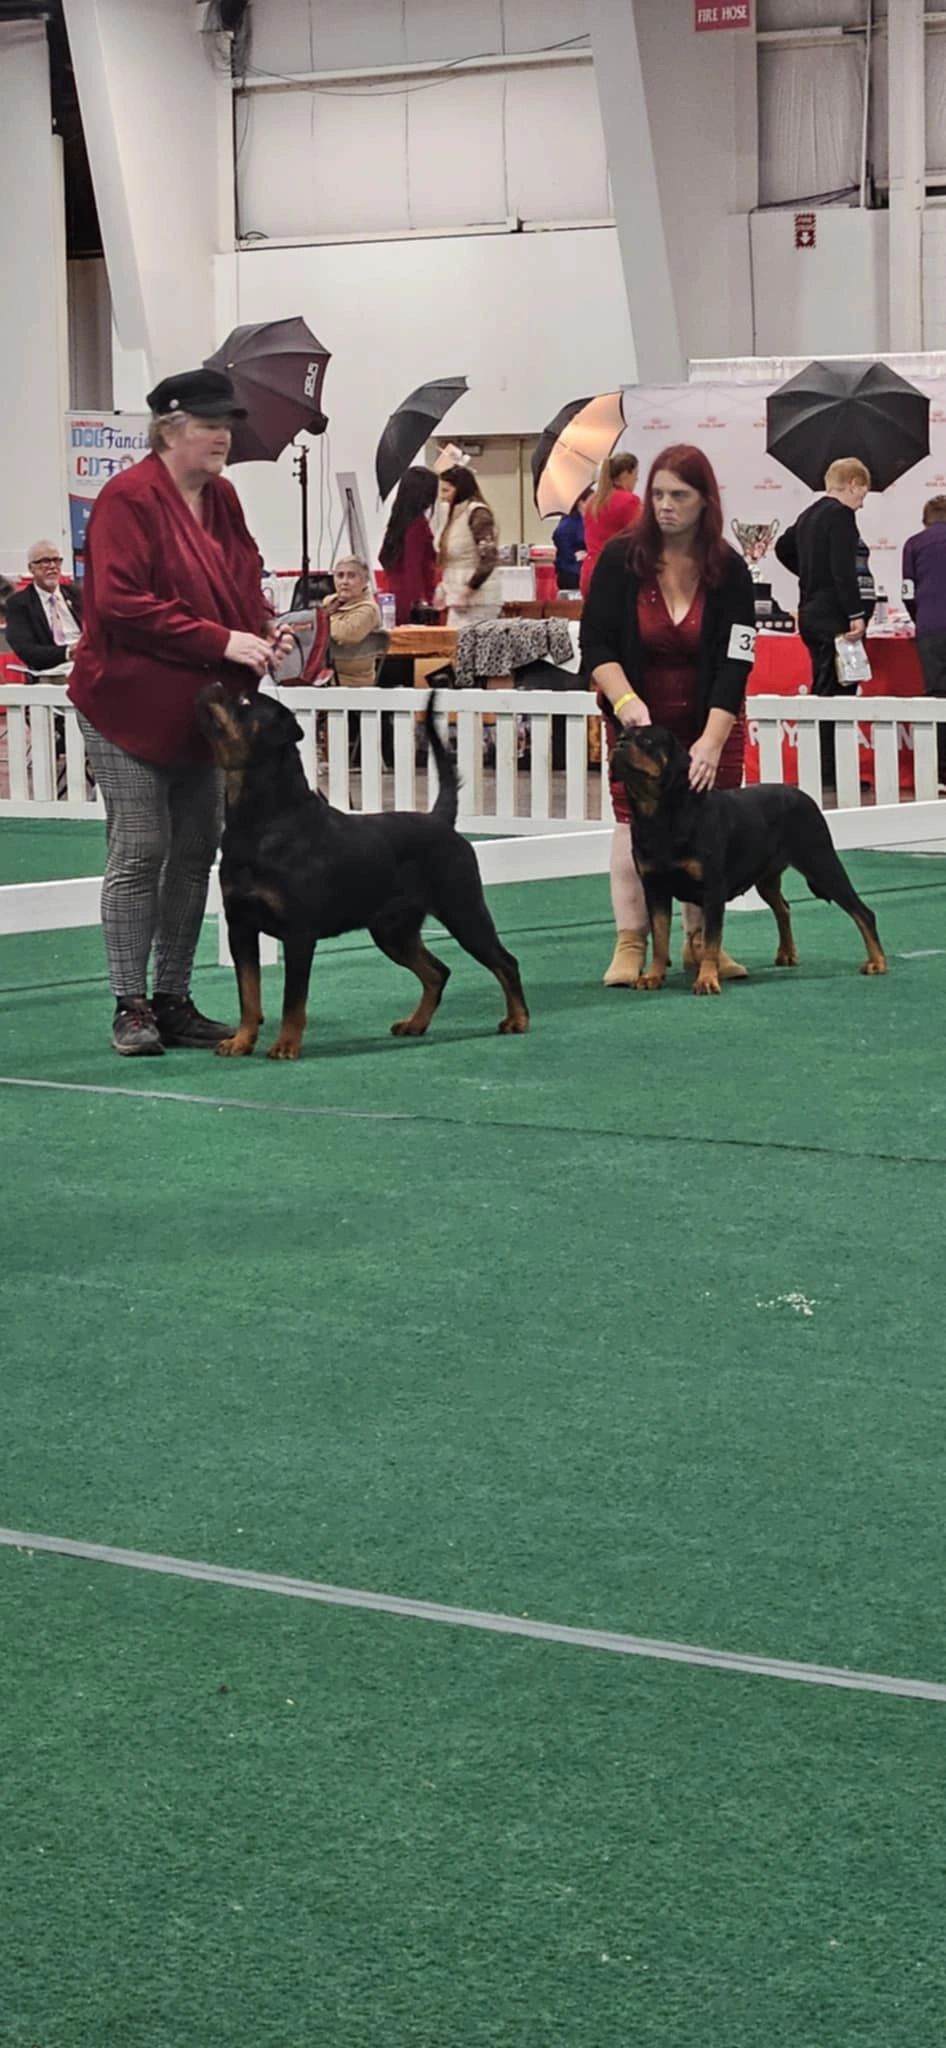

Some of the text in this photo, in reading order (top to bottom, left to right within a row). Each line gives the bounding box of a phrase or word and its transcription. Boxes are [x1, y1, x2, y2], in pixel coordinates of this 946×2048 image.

[698, 5, 747, 23] FIRE HOSE
[740, 633, 756, 652] 3
